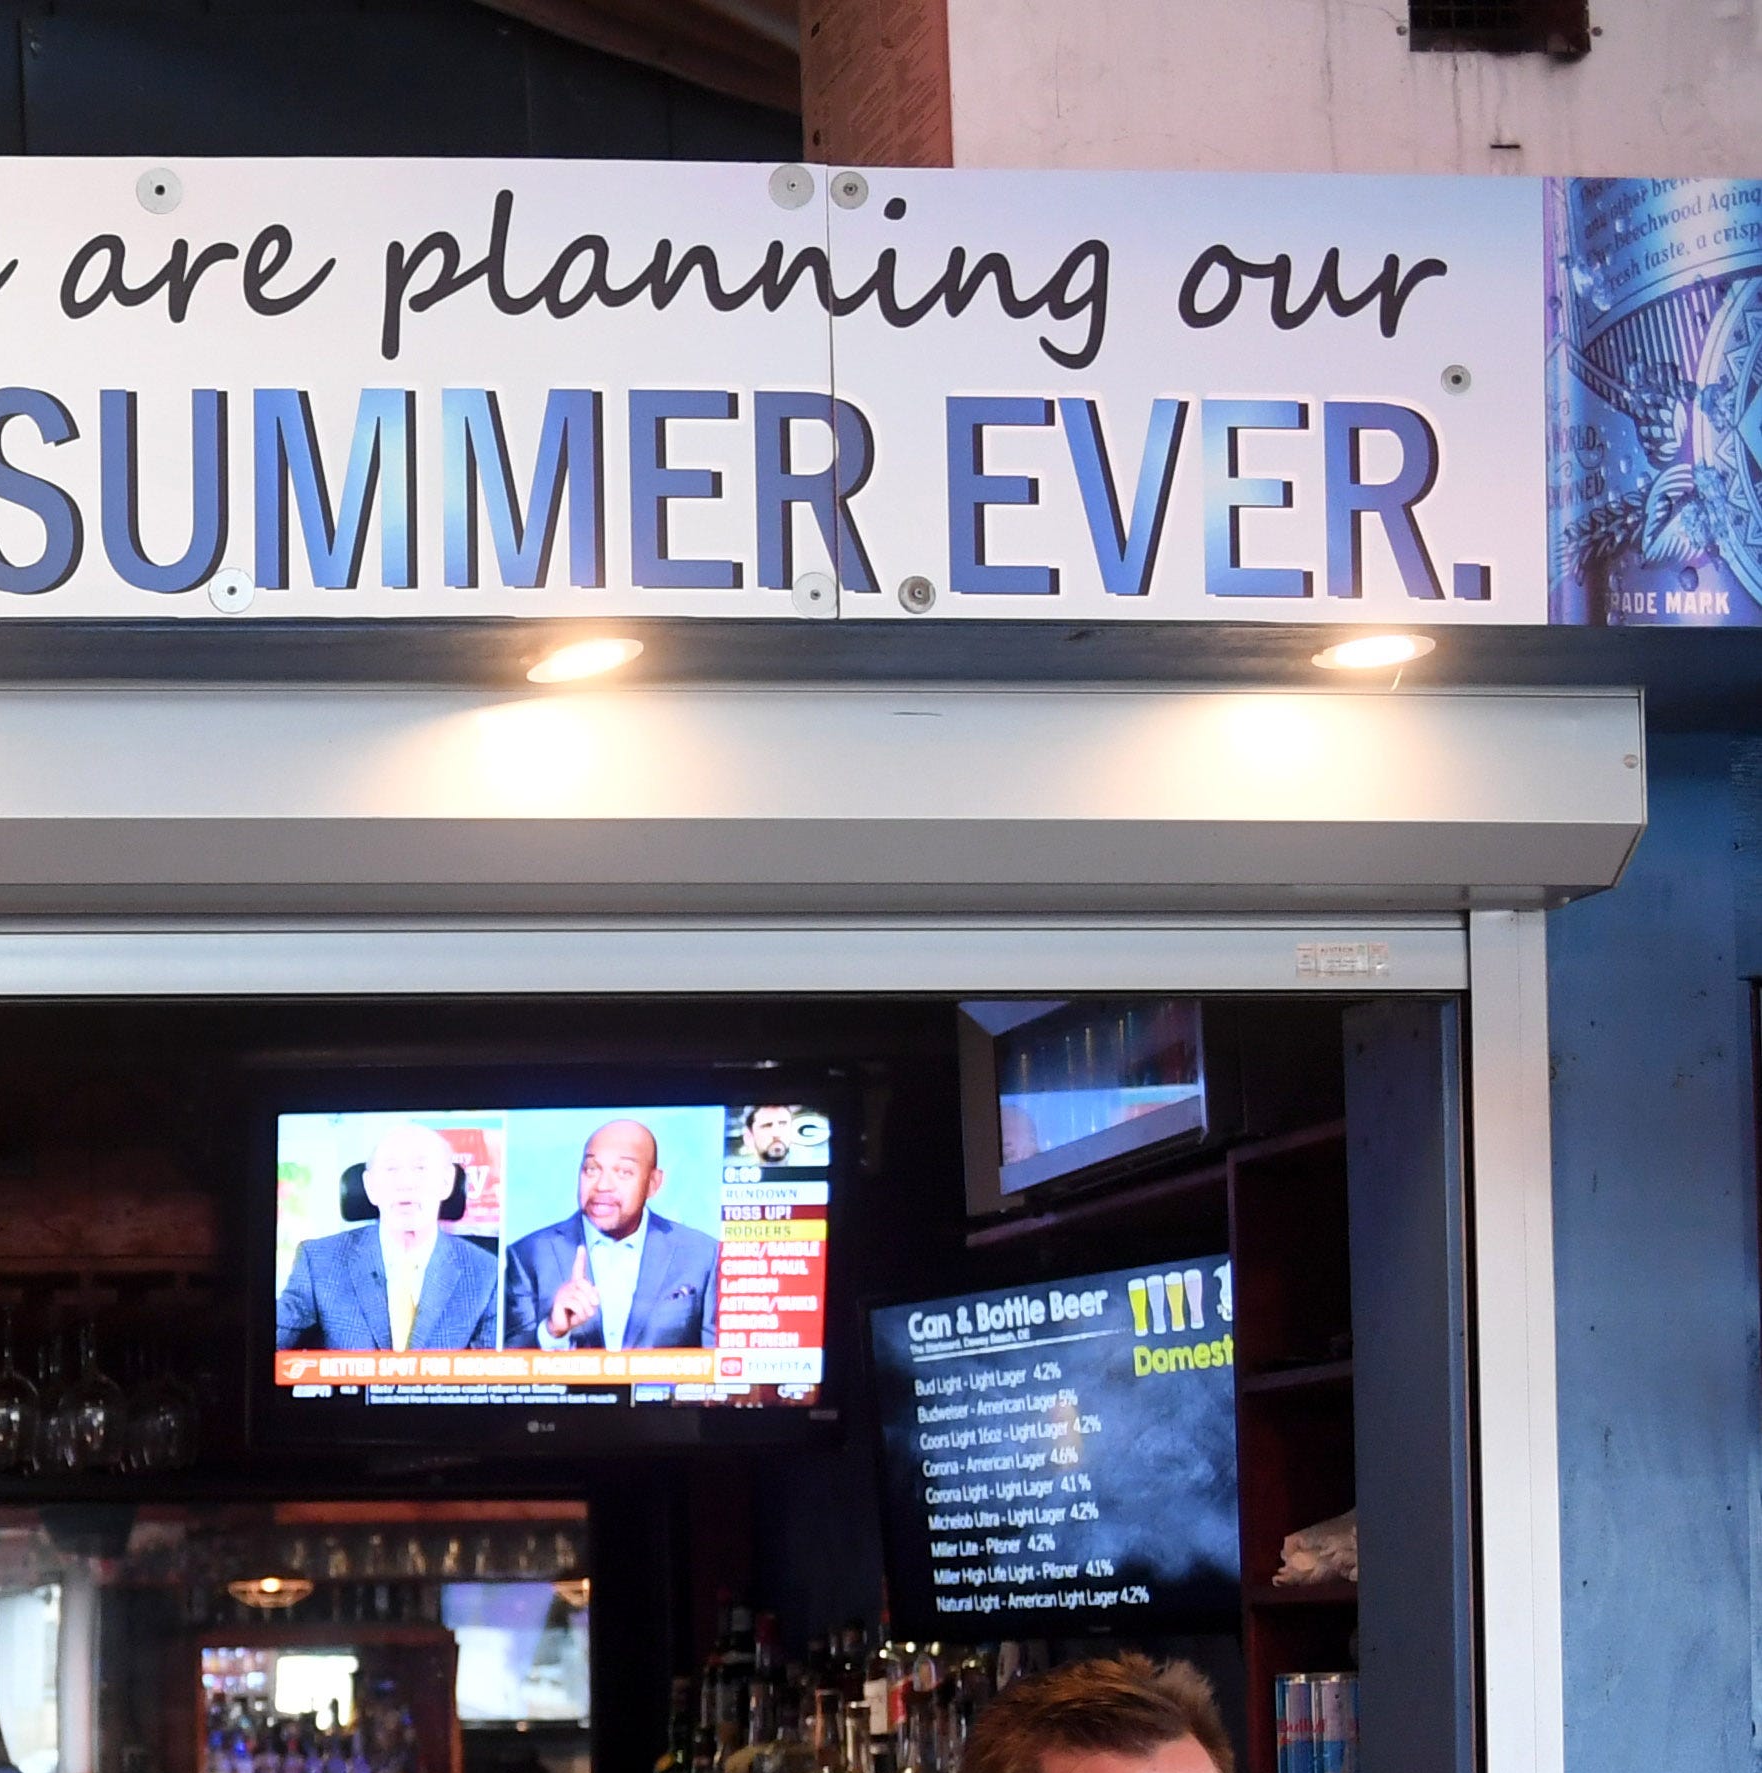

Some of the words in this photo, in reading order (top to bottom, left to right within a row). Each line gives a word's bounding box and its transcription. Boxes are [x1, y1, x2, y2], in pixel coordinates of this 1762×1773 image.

[60, 221, 337, 323] are
[382, 190, 1113, 370] planning
[1177, 244, 1449, 340] our
[947, 393, 1493, 600] EVER.
[1665, 591, 1730, 614] MARK
[724, 1206, 761, 1220] TOSS
[764, 1205, 792, 1220] UP!
[908, 1311, 952, 1342] Can
[956, 1305, 973, 1334] &
[976, 1295, 1045, 1332] Bottle
[1048, 1290, 1109, 1322] Beer
[748, 1362, 812, 1371] TOYOTA
[914, 1378, 936, 1397] Bud
[937, 1376, 962, 1395] Light
[969, 1372, 995, 1392] Light
[996, 1368, 1026, 1388] Lager
[917, 1404, 969, 1423] Budweiser
[977, 1396, 1025, 1416] American
[1026, 1393, 1057, 1413] Lager
[920, 1431, 950, 1450] Coors
[951, 1429, 976, 1449] Light
[1010, 1423, 1036, 1443] Light
[1037, 1420, 1068, 1440] Lager
[923, 1459, 959, 1477] Corona
[967, 1453, 1015, 1473] American
[1015, 1451, 1046, 1471] Lager
[926, 1486, 961, 1504] Corona
[962, 1483, 989, 1503] Light
[996, 1481, 1023, 1501] Light
[1024, 1478, 1054, 1498] Lager
[928, 1513, 973, 1531] Michelob
[974, 1510, 1000, 1529] Ultra
[1008, 1508, 1034, 1528] Light
[1035, 1505, 1066, 1525] Lager
[931, 1541, 958, 1558] Miller
[959, 1539, 979, 1557] Lite
[986, 1536, 1022, 1555] Pilsner
[934, 1568, 960, 1585] Miller
[962, 1567, 987, 1587] High
[987, 1566, 1008, 1583] Life
[1008, 1564, 1035, 1584] Light
[1042, 1561, 1079, 1580] Pilsner
[936, 1594, 973, 1613] Natural
[974, 1593, 1000, 1614] Light
[1008, 1590, 1057, 1609] American
[1058, 1589, 1085, 1610] Light
[1086, 1588, 1118, 1609] Lager
